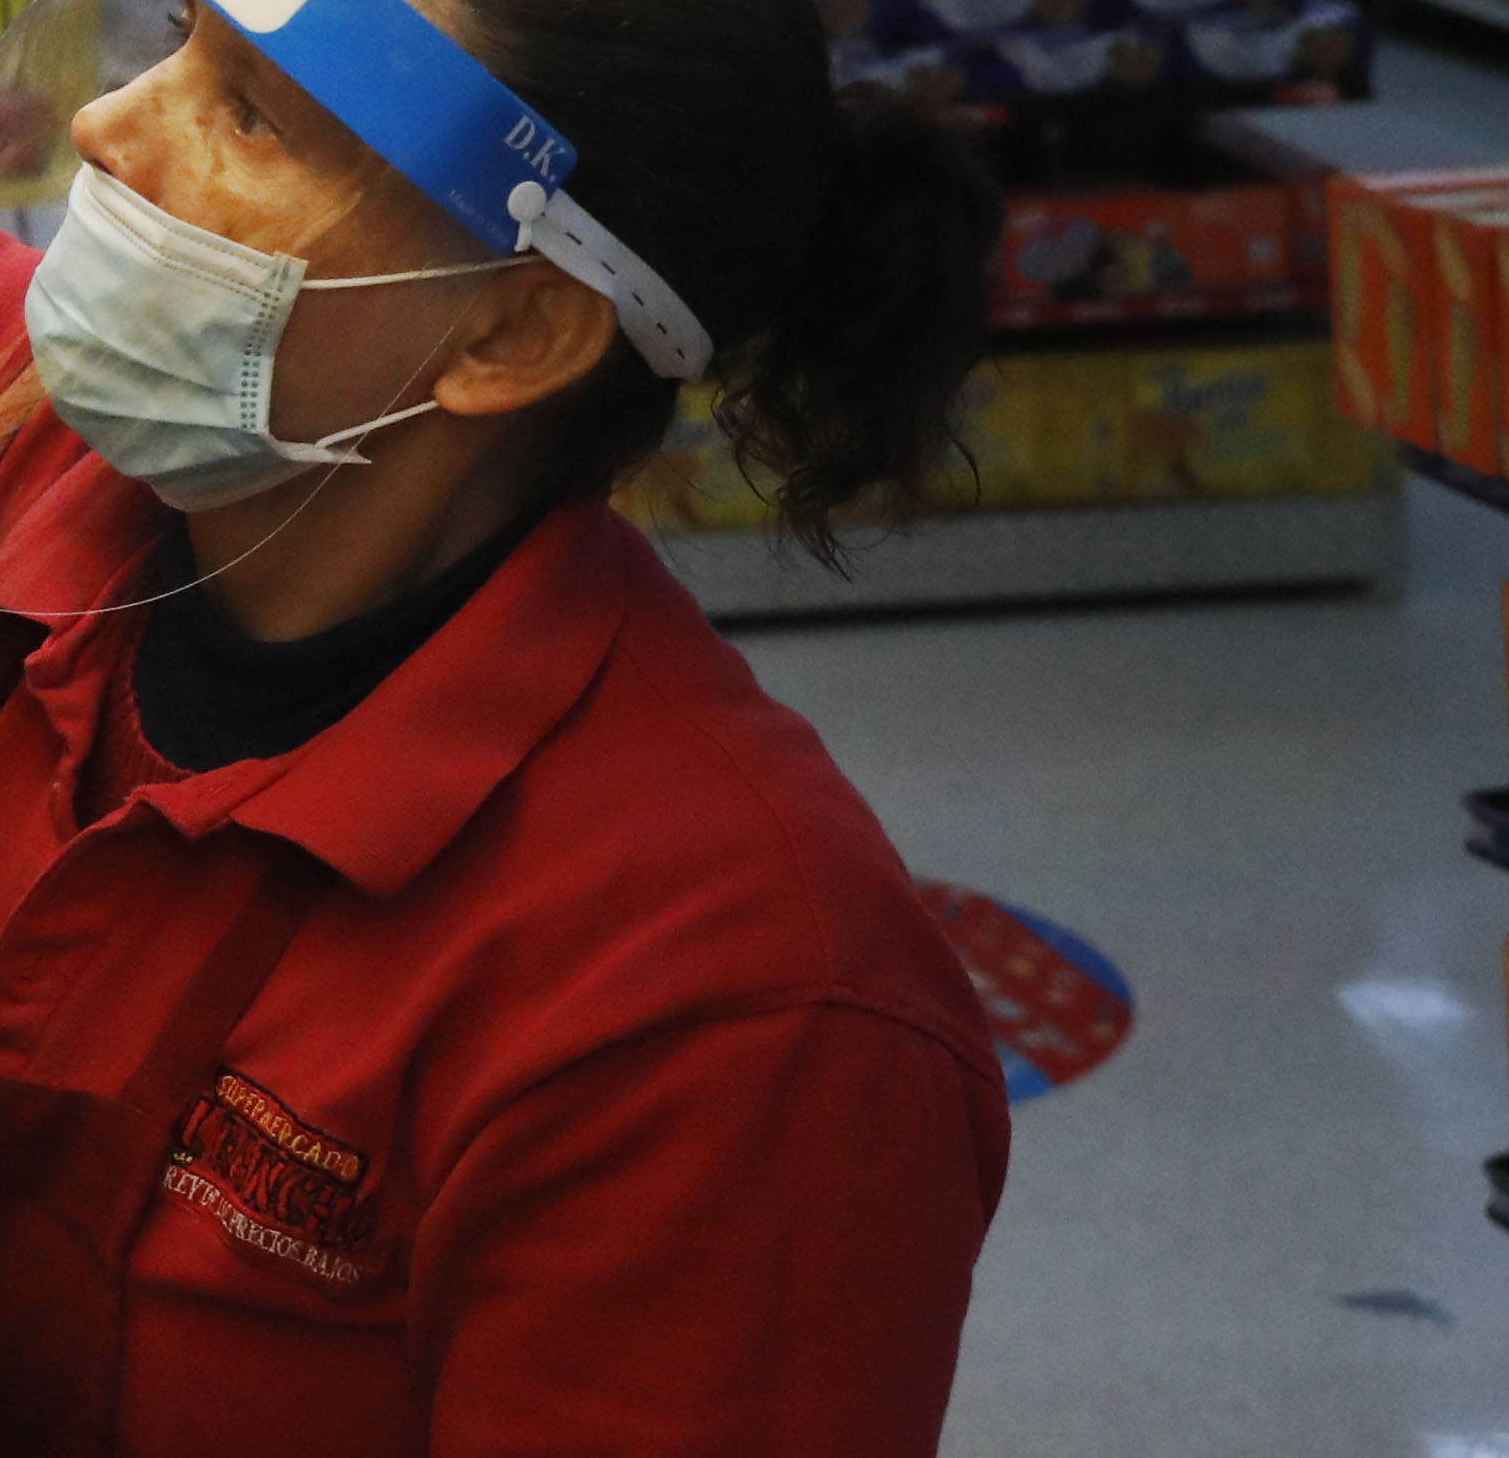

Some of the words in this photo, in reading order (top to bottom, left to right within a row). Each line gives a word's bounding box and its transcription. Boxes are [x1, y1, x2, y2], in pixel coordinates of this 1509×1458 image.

[503, 114, 565, 183] D.K.
[216, 1074, 361, 1179] SUPERMERCADO
[226, 1210, 302, 1264] PRECIOS
[303, 1246, 361, 1285] BAJOS
